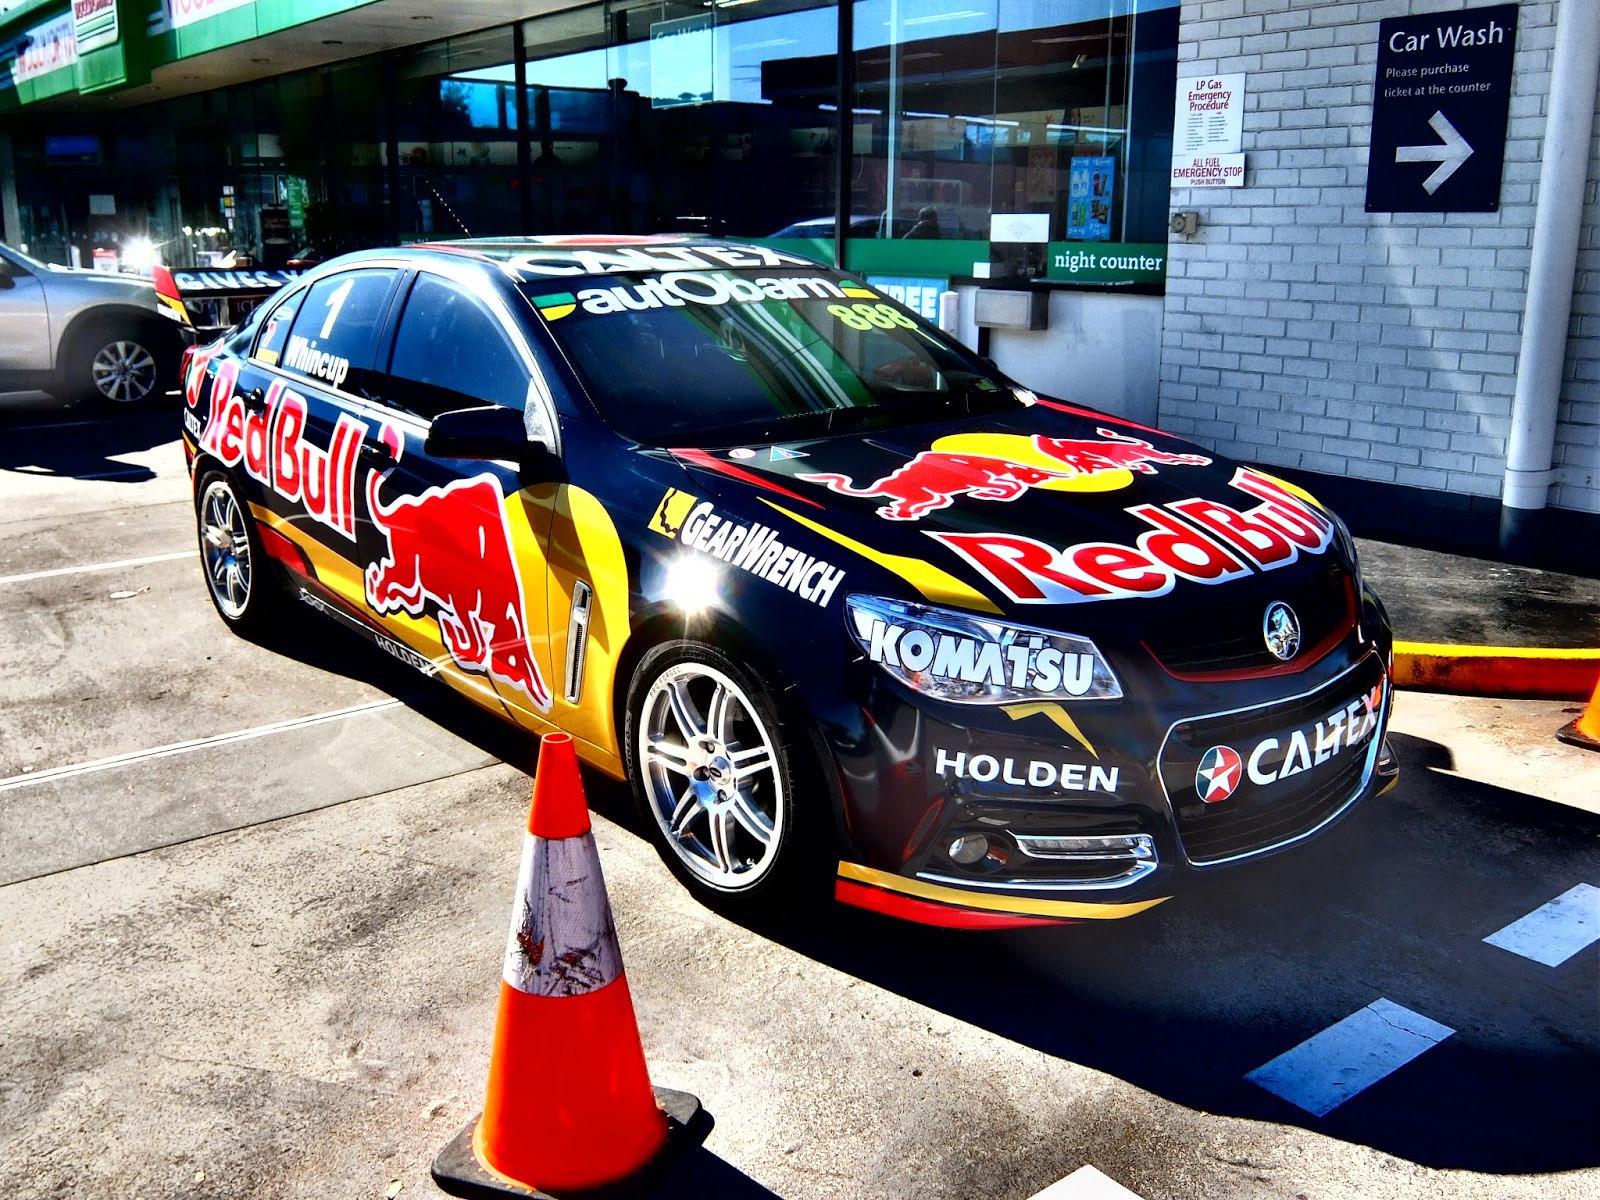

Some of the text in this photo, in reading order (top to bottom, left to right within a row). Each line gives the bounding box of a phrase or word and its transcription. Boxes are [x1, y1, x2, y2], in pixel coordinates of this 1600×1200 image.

[1389, 20, 1503, 53] Car Wash
[1386, 63, 1470, 78] Please purchase
[1196, 79, 1222, 91] LP Gas
[1384, 82, 1491, 97] ticket at the counter
[1188, 91, 1232, 103] Emergency
[1189, 100, 1229, 111] Procedure
[1173, 166, 1243, 178] EMERGENCY STOP
[1192, 157, 1221, 168] ALL FUEL
[508, 245, 814, 276] CALTEX
[1055, 250, 1163, 273] night counter
[174, 270, 282, 290] GIVES
[319, 278, 355, 340] 1
[827, 303, 919, 331] 888
[284, 334, 349, 390] Whincup
[869, 619, 1096, 696] KOMATSU
[1247, 686, 1379, 785] CALTEX
[935, 748, 1120, 793] HOLDEN
